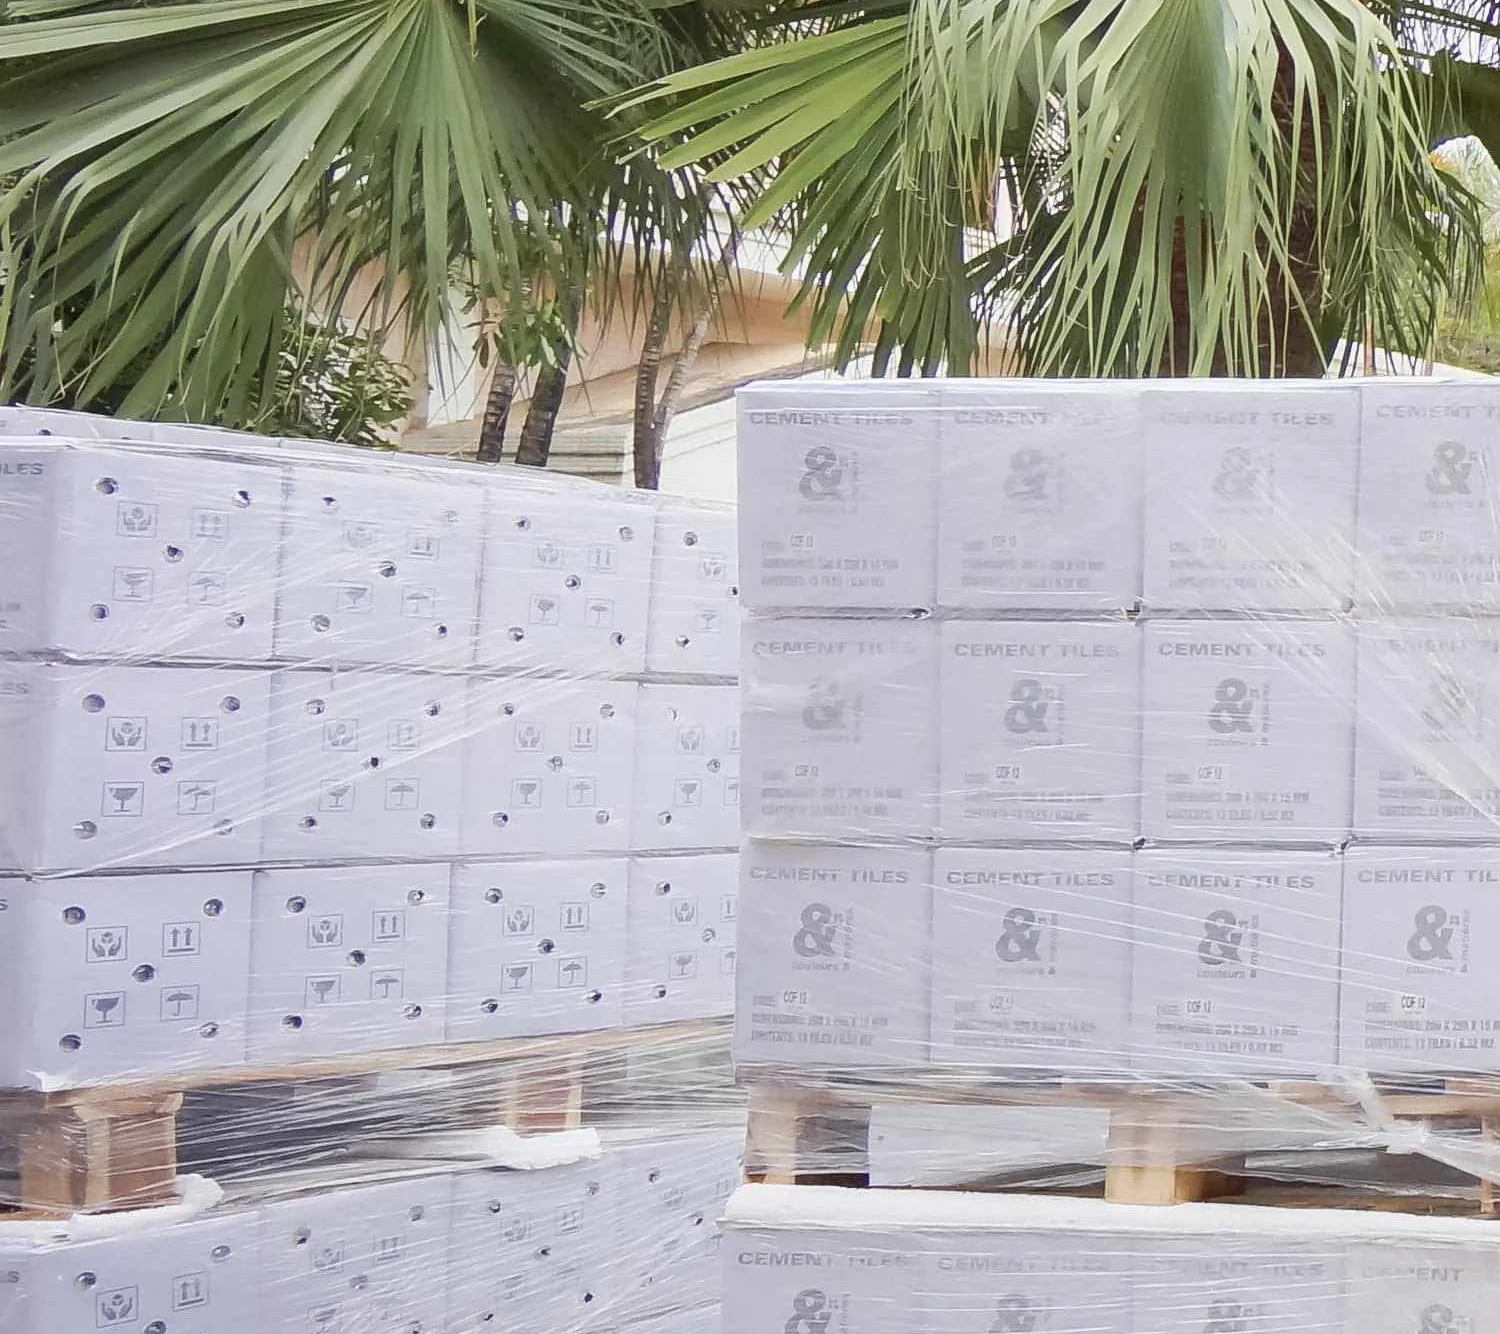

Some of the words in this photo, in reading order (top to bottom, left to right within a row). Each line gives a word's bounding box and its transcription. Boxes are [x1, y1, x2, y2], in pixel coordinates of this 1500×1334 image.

[1376, 405, 1473, 419] CEMENT
[750, 413, 842, 426] CEMENT
[1424, 441, 1473, 498] &
[752, 642, 846, 655] CEMENT
[954, 644, 1048, 657] CEMENT
[1060, 644, 1119, 658] TILES
[1159, 643, 1254, 657] CEMENT
[1001, 678, 1048, 733] &
[750, 868, 840, 882] CEMENT
[850, 870, 908, 884] TILES
[947, 872, 1042, 886] CEMENT
[1053, 873, 1114, 886] TILES
[1254, 875, 1314, 889] TILES
[1358, 869, 1454, 883] CEMENT
[794, 903, 838, 956] &
[995, 906, 1042, 962] &
[1406, 904, 1454, 960] &
[1195, 909, 1242, 965] &
[1417, 997, 1425, 1009] 12
[738, 1252, 833, 1267] CEMENT
